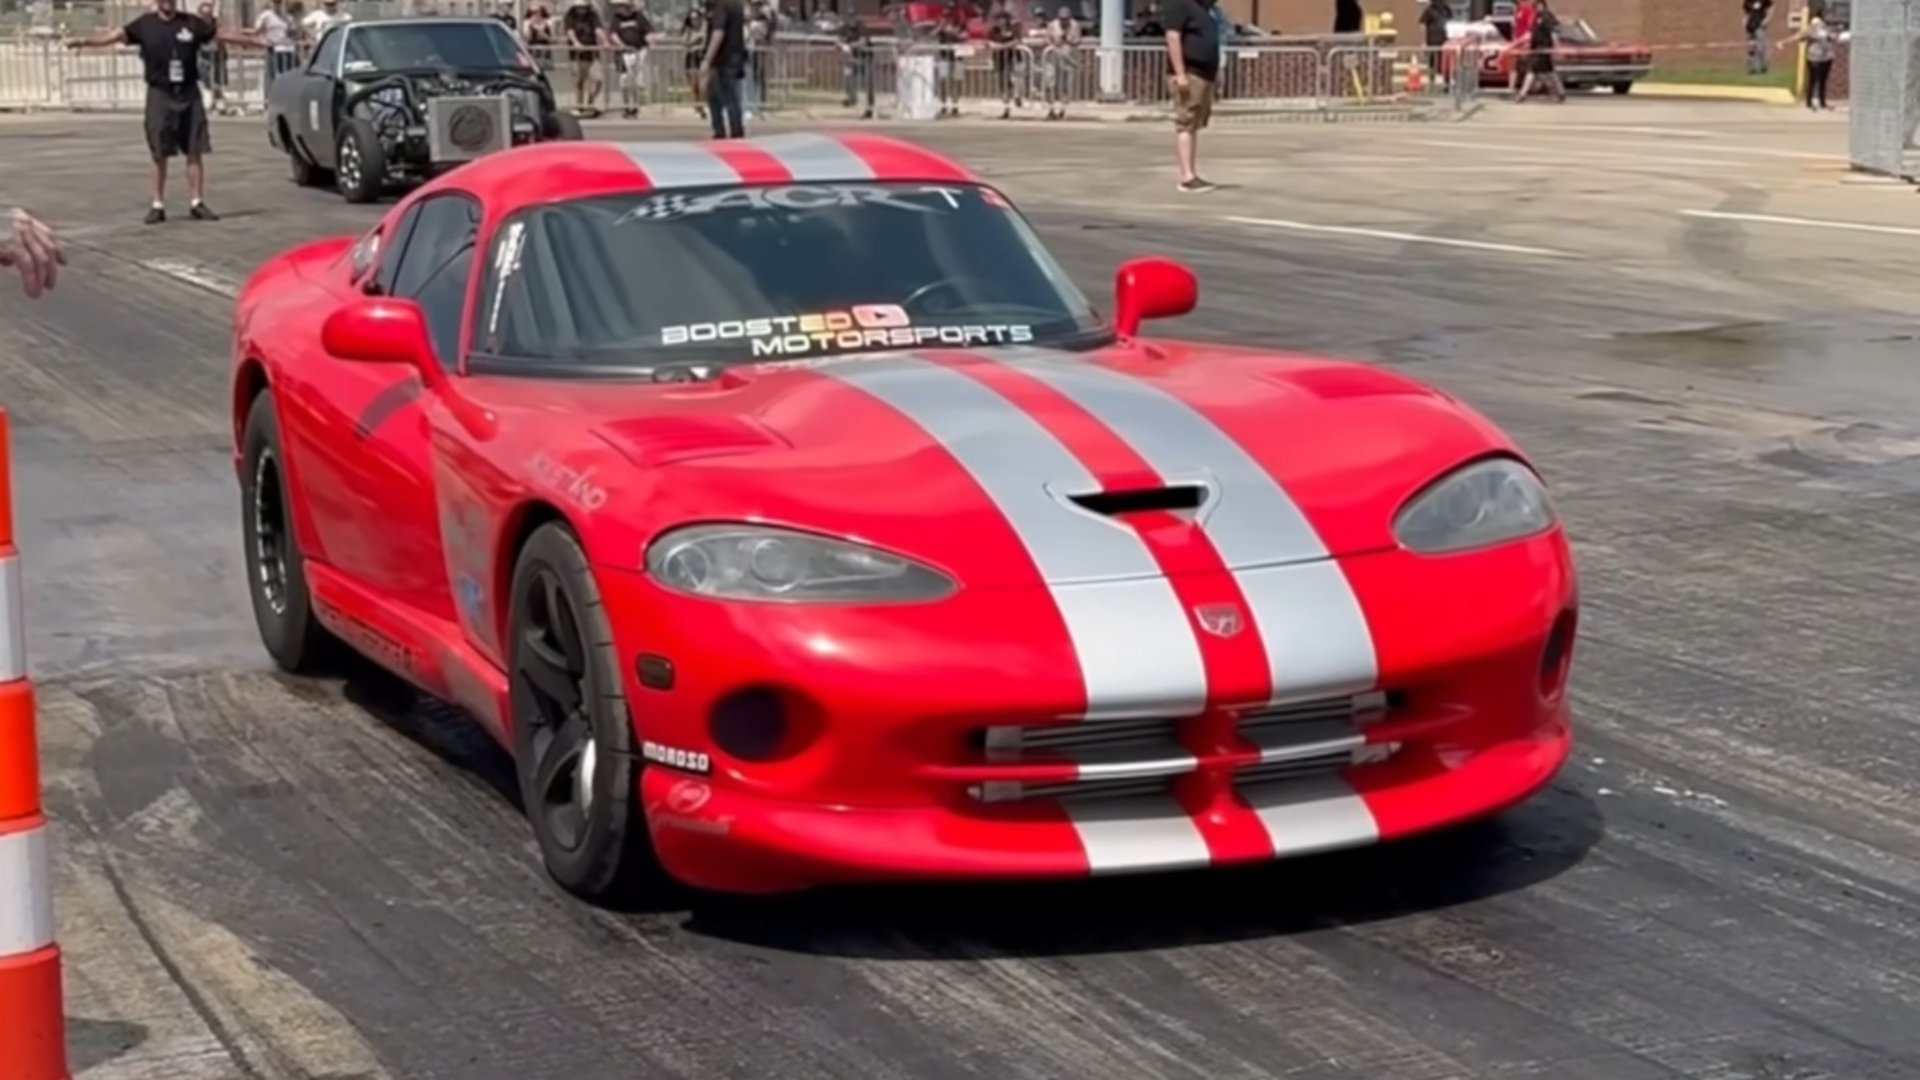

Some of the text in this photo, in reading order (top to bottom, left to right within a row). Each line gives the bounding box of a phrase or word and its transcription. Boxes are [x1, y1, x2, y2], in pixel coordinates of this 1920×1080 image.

[684, 185, 908, 213] ACR
[661, 311, 853, 344] BOOSTED
[752, 324, 1034, 356] MOTORSPORTS
[643, 740, 709, 772] MOROSO
